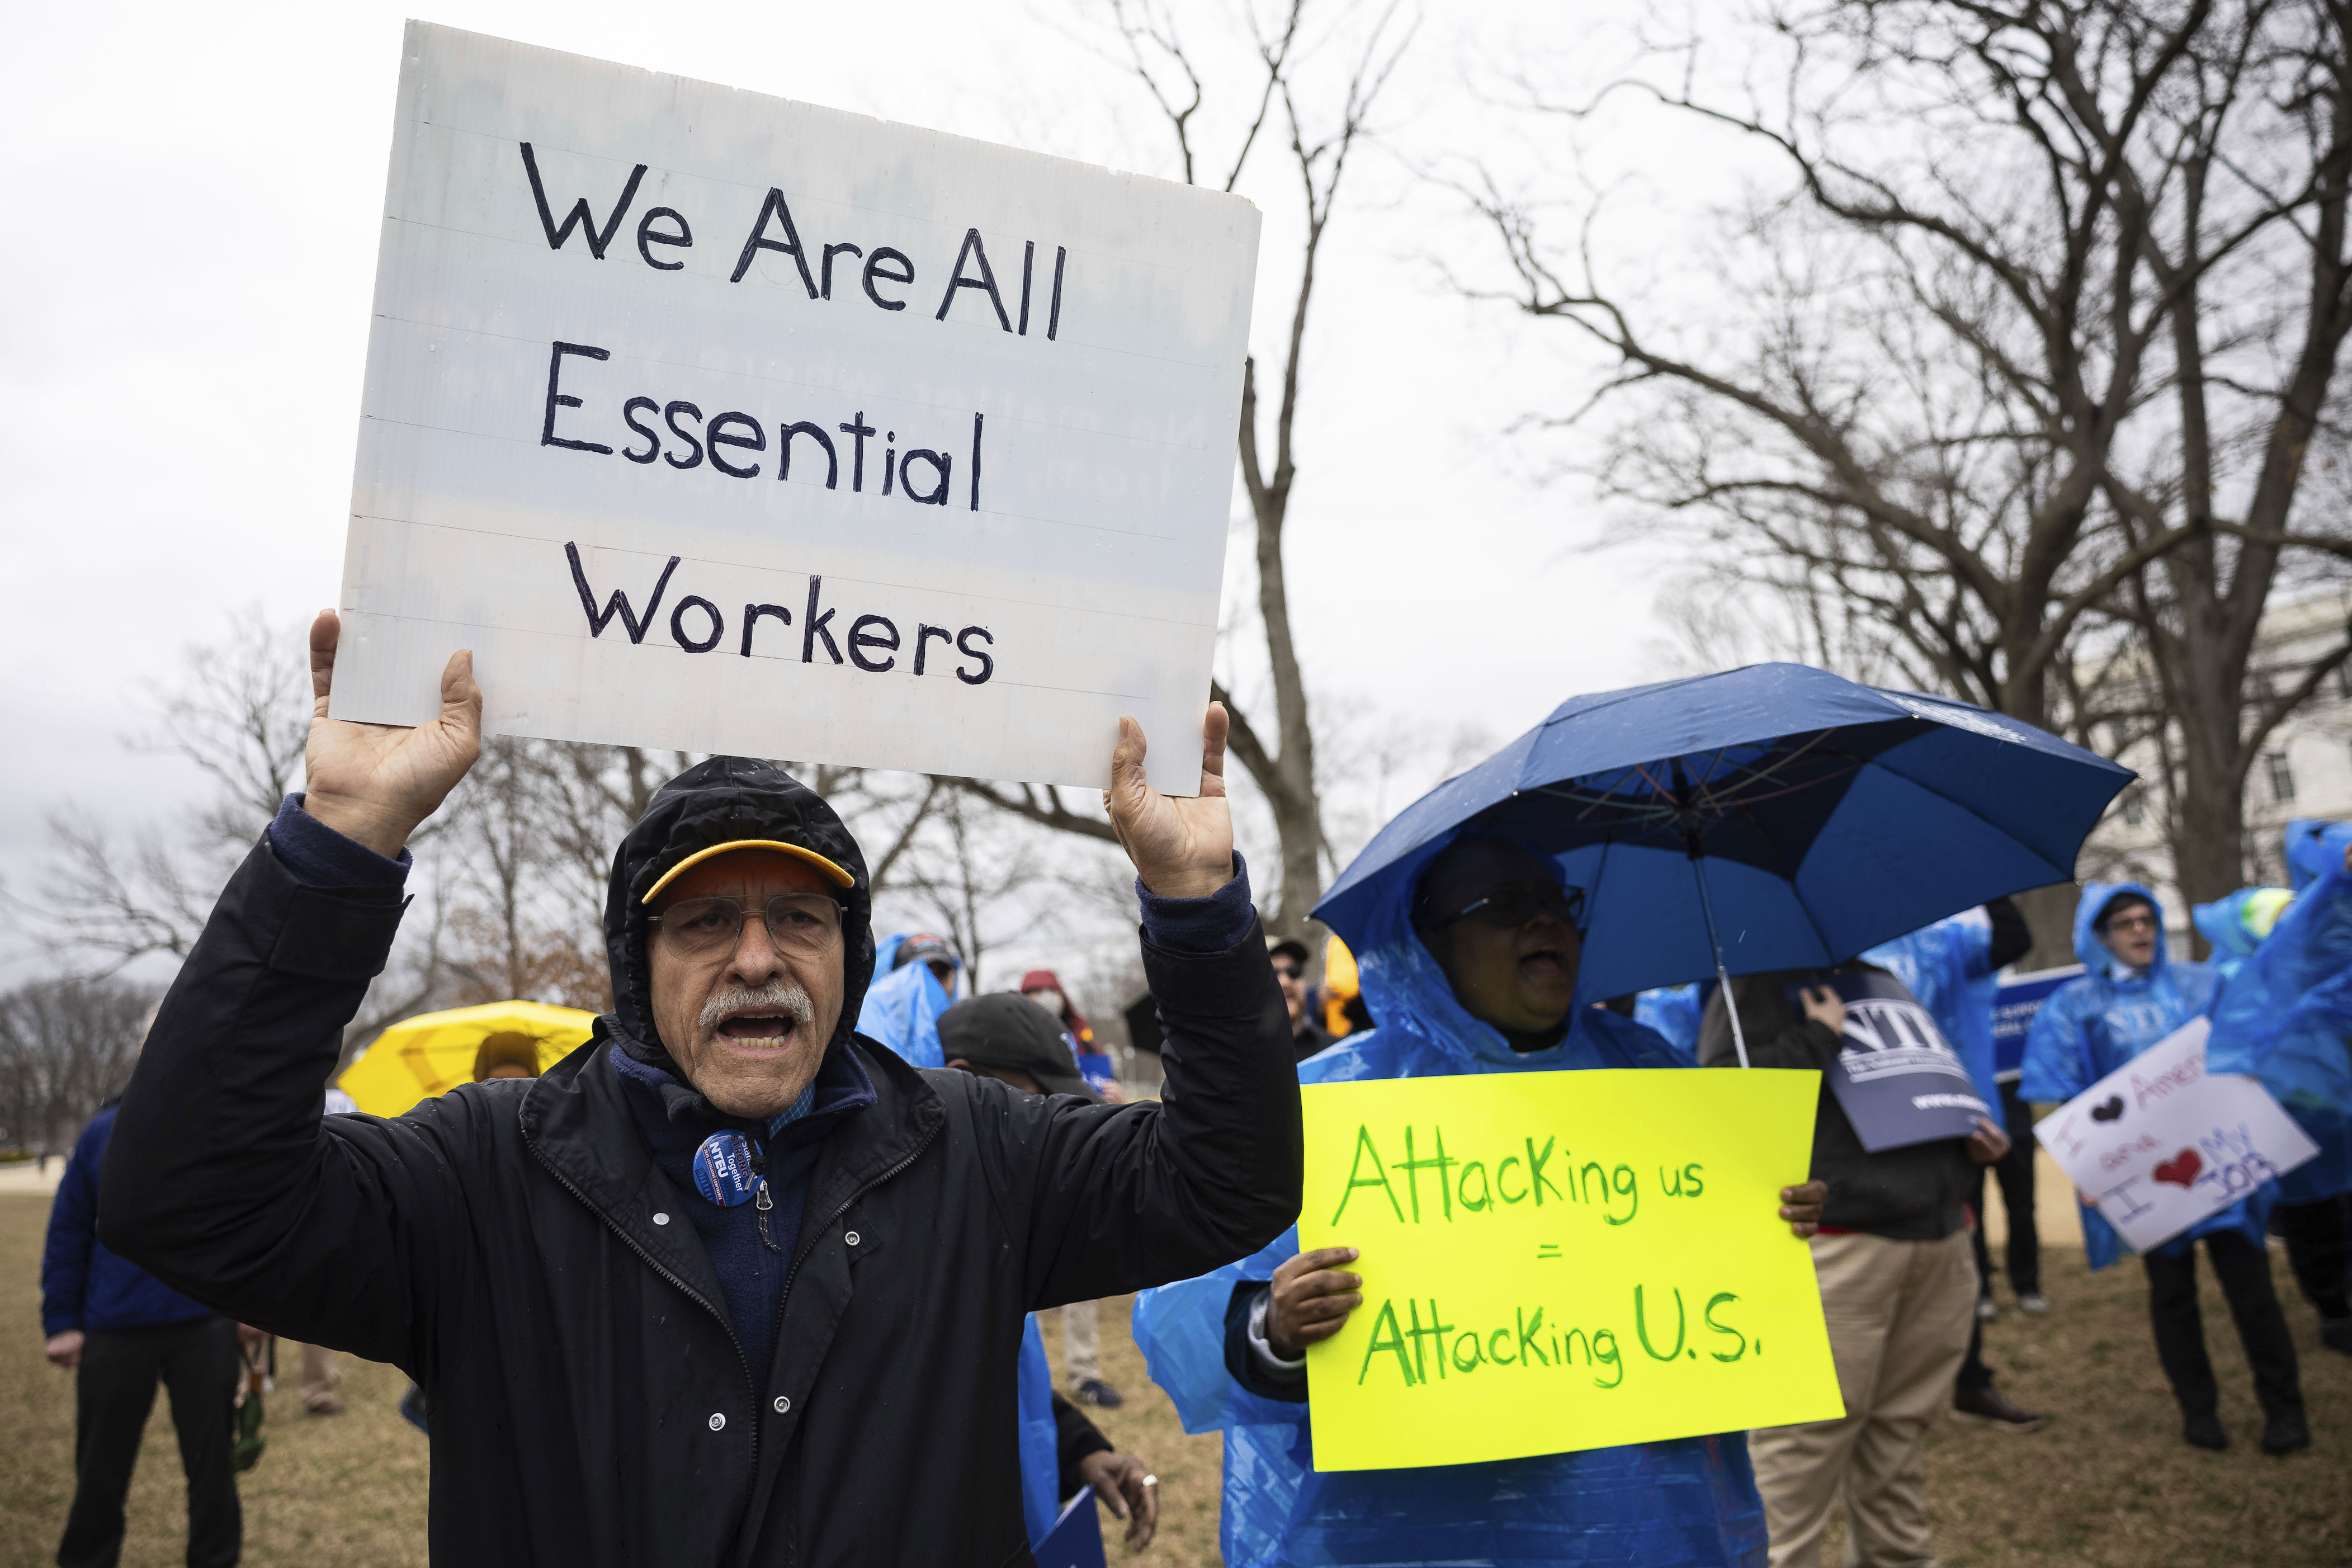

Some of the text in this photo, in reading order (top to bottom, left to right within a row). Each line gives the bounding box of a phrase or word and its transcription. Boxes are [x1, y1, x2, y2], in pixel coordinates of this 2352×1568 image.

[520, 142, 1066, 341] We Are All
[541, 341, 983, 512] Essential
[564, 541, 993, 684] Workers
[706, 1159, 716, 1179] LEGISLATIVE
[713, 1178, 723, 1201] CONFERENCE
[709, 1141, 729, 1178] NTEU
[727, 1153, 743, 1192] Together
[730, 1135, 749, 1177] STRONG
[1660, 1163, 1703, 1197] us
[2188, 1149, 2280, 1207] JOB
[2098, 1174, 2156, 1226] I
[1635, 1284, 1761, 1362] U.S.
